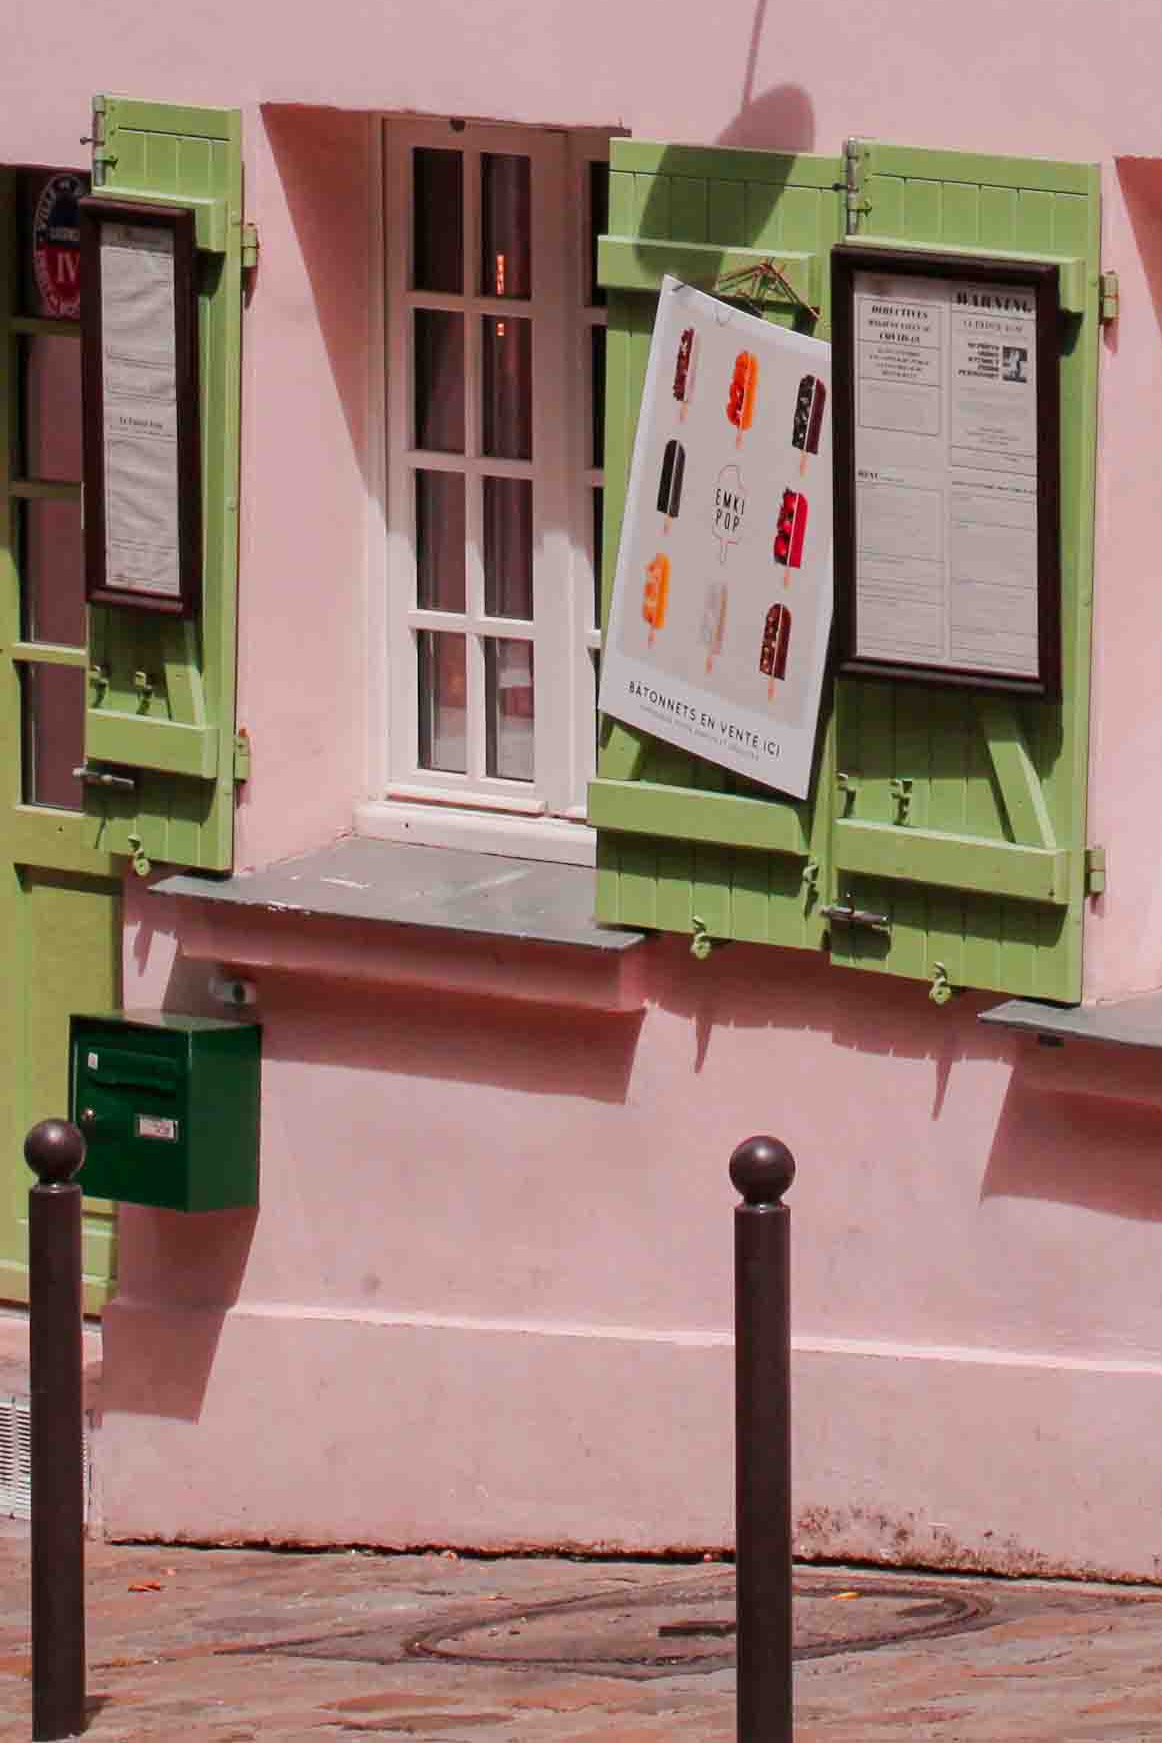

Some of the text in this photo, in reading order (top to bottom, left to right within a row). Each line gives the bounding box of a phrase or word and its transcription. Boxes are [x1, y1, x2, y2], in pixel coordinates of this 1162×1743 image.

[715, 488, 746, 515] EMKI
[715, 508, 741, 533] POP
[700, 712, 716, 730] EN
[720, 721, 760, 748] VENTE
[763, 740, 781, 758] ICI
